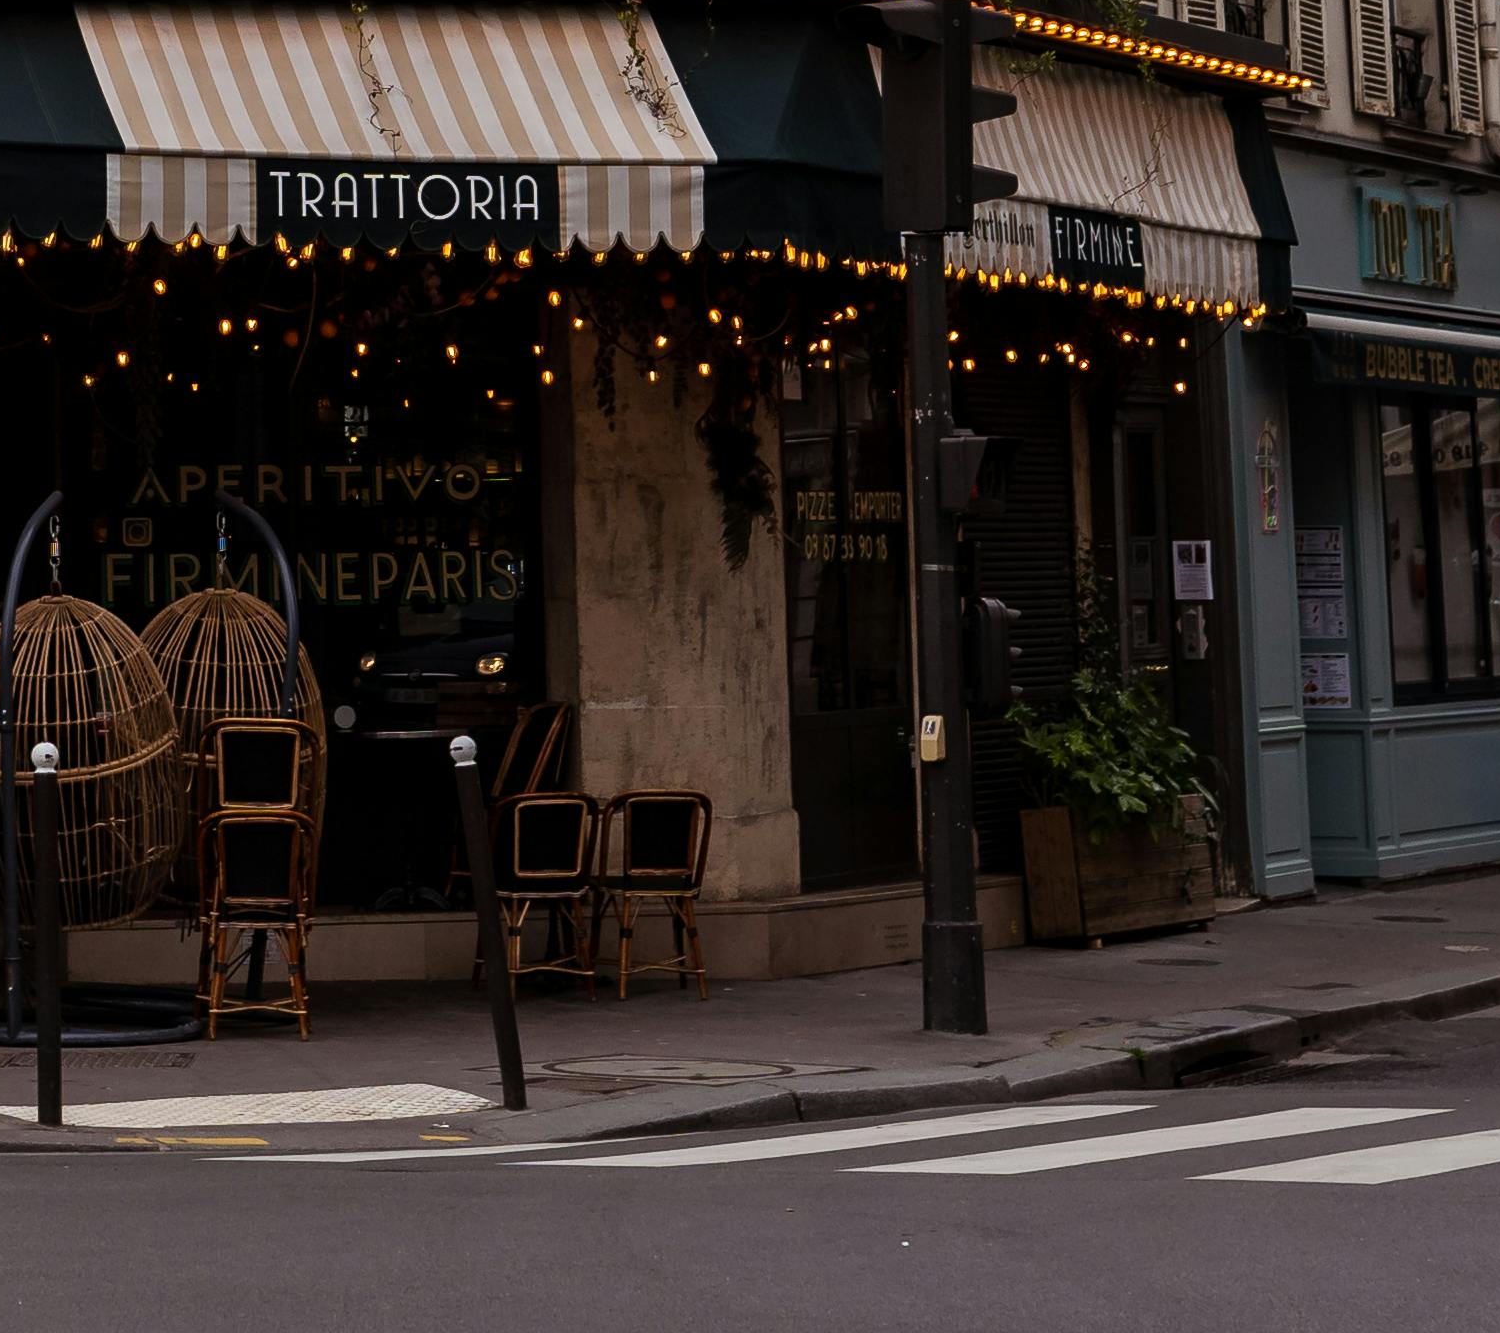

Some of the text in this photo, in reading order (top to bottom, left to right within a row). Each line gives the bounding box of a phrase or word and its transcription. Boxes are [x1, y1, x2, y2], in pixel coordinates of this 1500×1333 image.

[268, 170, 539, 221] TRATTORIA
[1053, 215, 1144, 268] FIRMINE
[1370, 197, 1456, 290] TOP TEA
[1365, 341, 1426, 383] BUBBLE
[1427, 349, 1457, 387] TEA
[129, 462, 482, 504] APERITIVO
[796, 490, 838, 521] PIZZE
